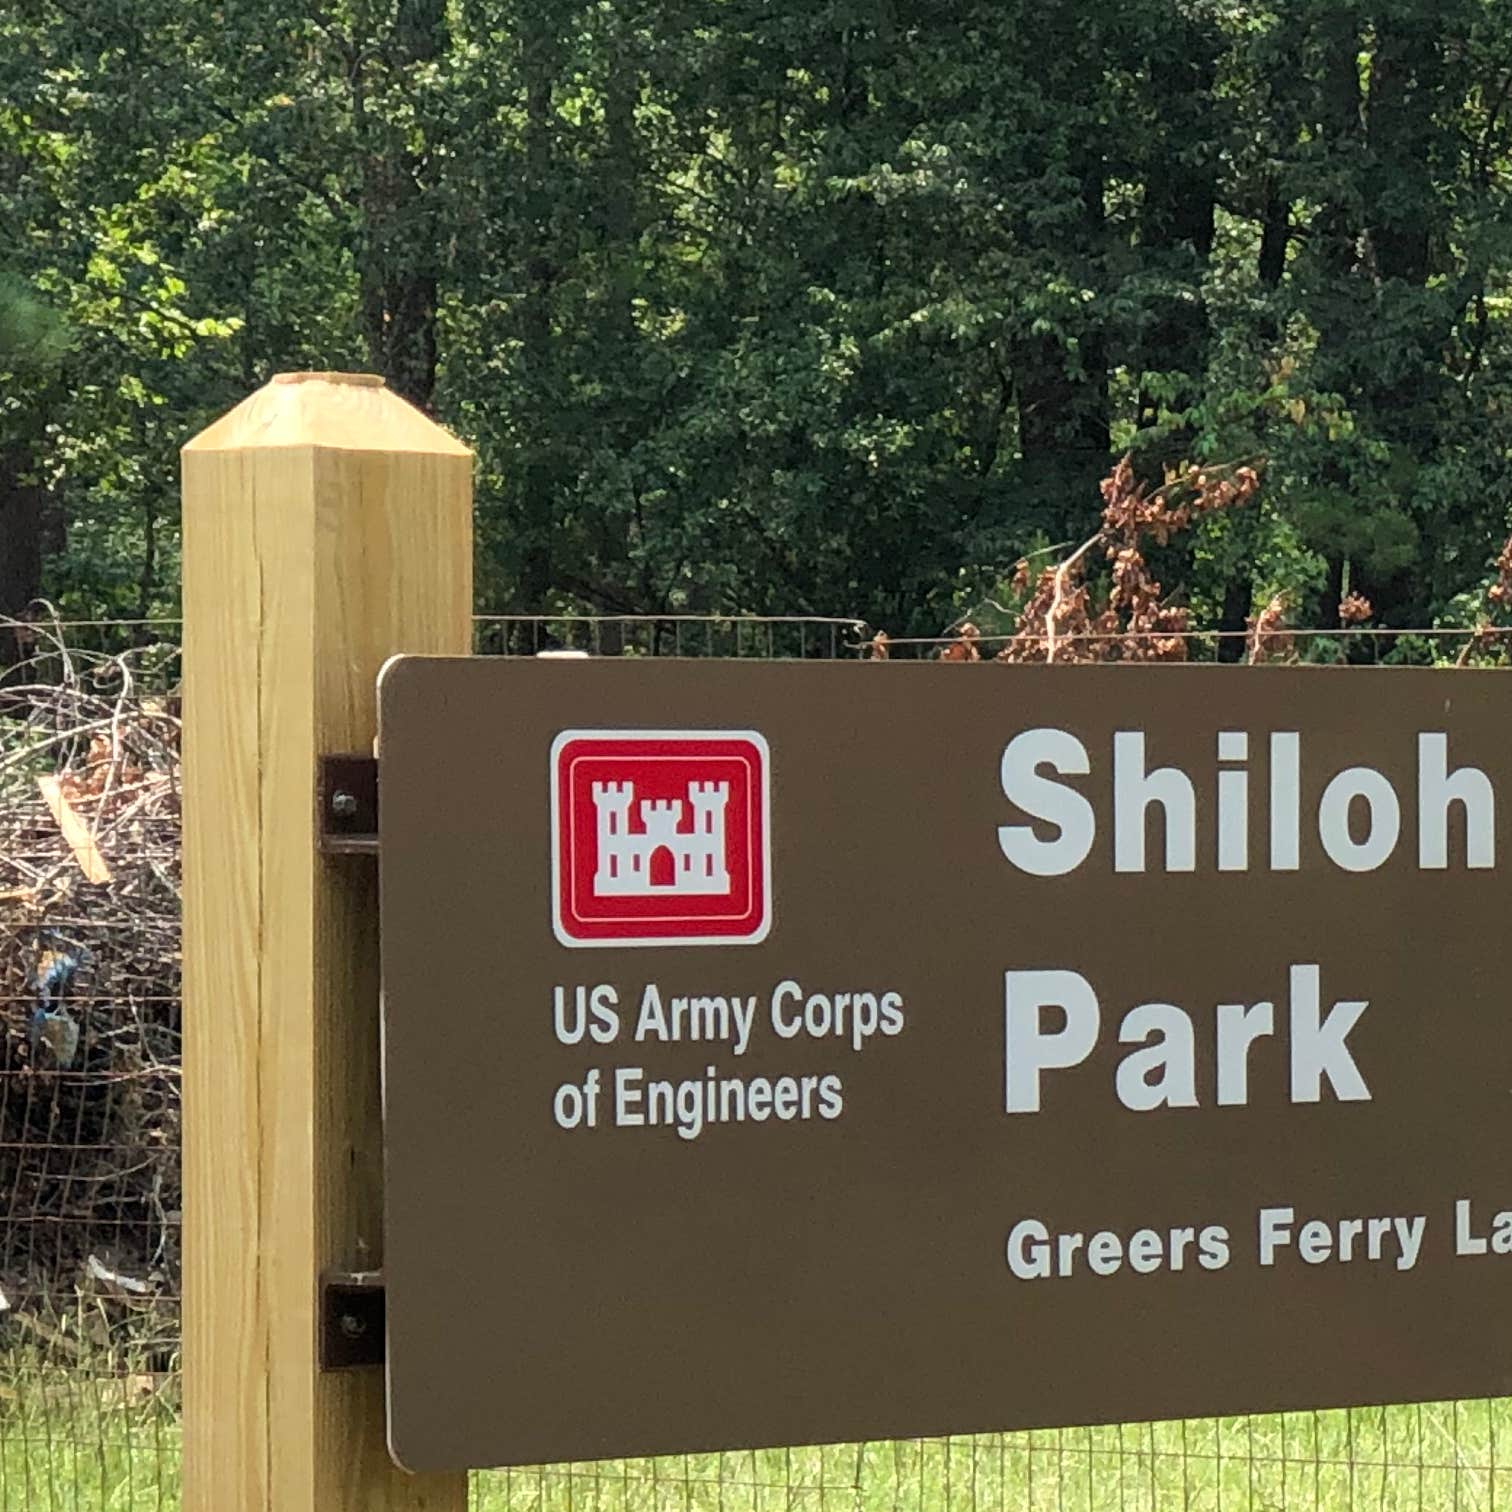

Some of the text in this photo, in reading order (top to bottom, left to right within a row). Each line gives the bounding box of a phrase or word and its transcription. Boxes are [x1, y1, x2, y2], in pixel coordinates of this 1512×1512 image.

[997, 728, 1495, 876] Shiloh
[554, 980, 905, 1056] US Army Corps
[1005, 964, 1372, 1114] Park
[554, 1066, 843, 1140] of Engineers
[1007, 1219, 1230, 1280] Greers
[1259, 1207, 1426, 1270] Ferry
